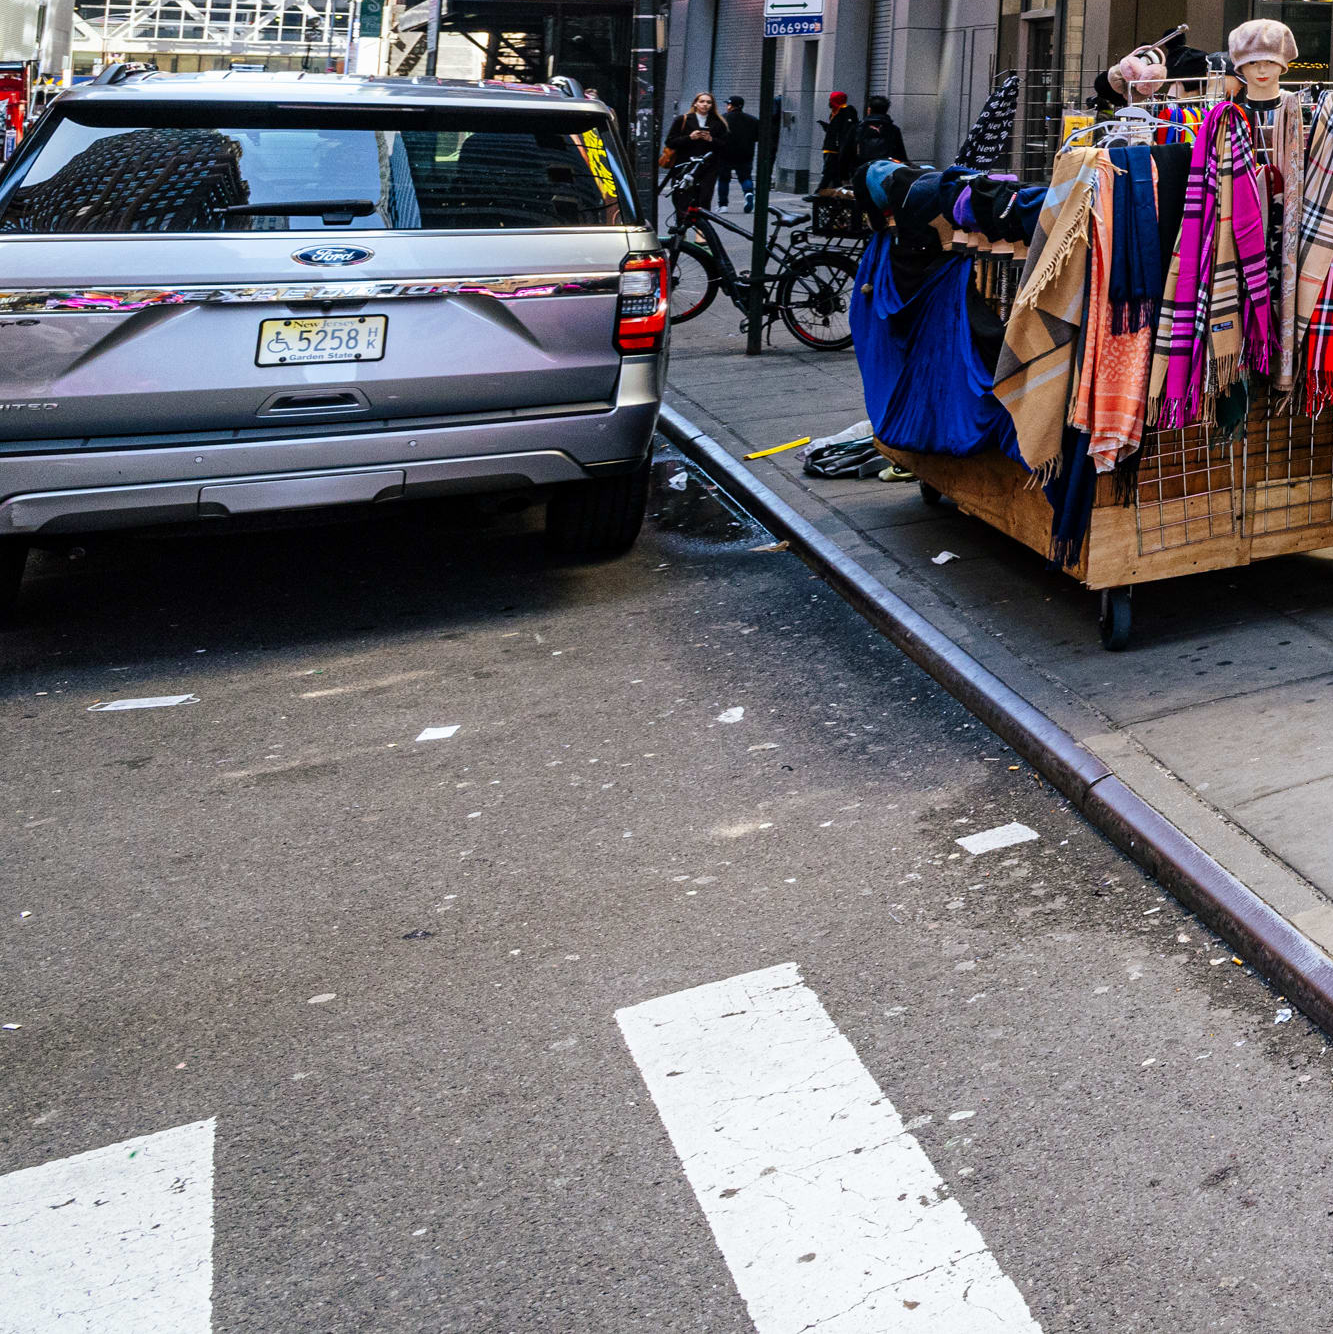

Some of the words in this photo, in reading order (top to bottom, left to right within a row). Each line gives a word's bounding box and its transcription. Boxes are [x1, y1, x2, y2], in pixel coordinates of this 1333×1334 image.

[311, 248, 354, 264] Ford
[293, 320, 321, 329] New
[321, 319, 356, 330] Jersey
[297, 328, 360, 352] 5258
[367, 327, 379, 337] H
[366, 338, 376, 350] K
[289, 353, 324, 362] Garden
[327, 352, 353, 361] State
